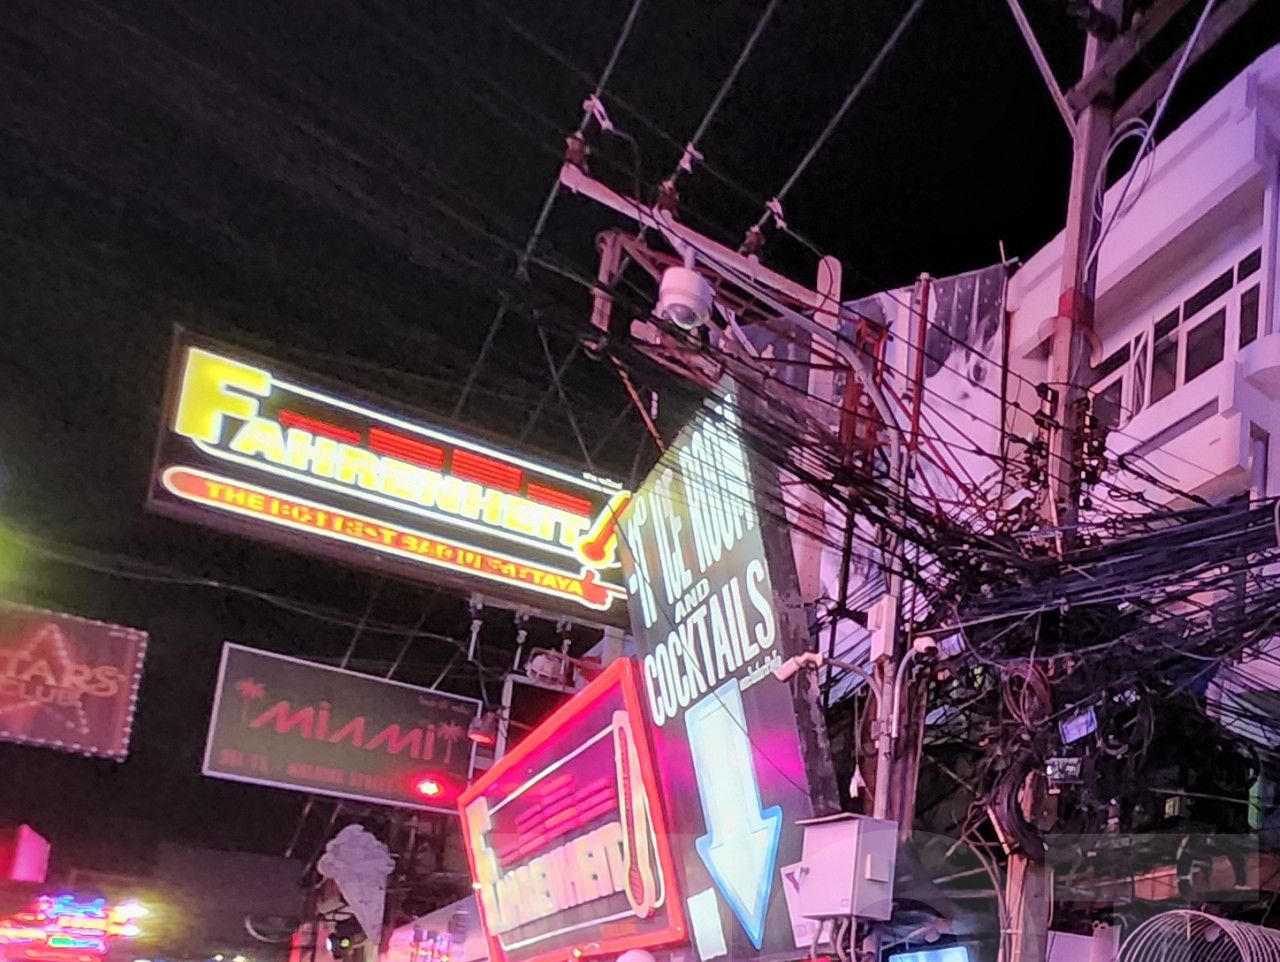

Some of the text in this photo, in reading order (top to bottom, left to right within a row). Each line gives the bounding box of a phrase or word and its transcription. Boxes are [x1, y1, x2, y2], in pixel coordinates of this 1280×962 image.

[173, 345, 591, 547] FAHRENHEIT
[205, 482, 265, 512] THE
[644, 560, 776, 727] COCKTAILS
[674, 578, 709, 624] AND
